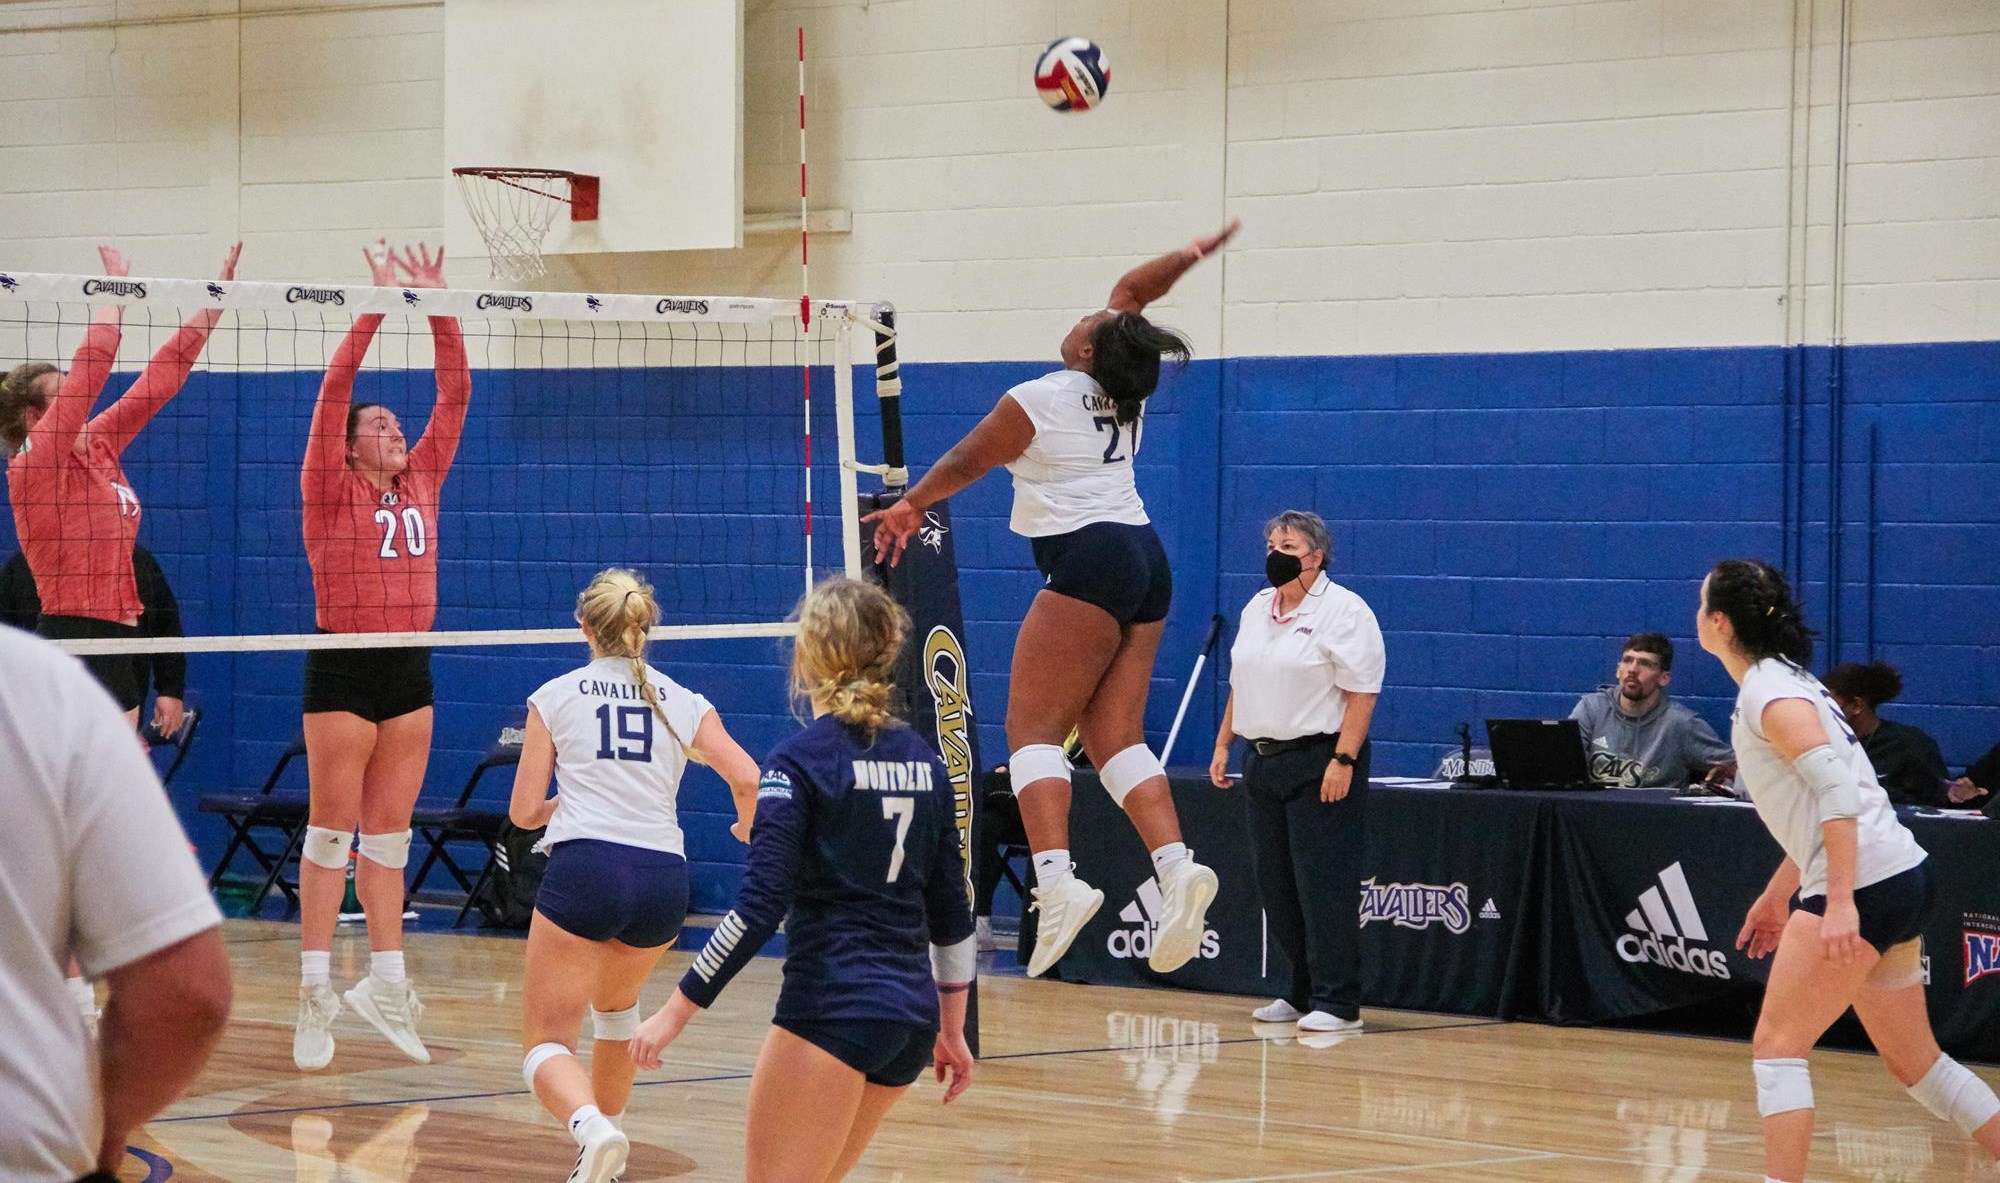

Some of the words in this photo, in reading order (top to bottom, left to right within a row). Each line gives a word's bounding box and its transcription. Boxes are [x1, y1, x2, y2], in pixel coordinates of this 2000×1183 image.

[83, 279, 147, 299] CAVALIERS
[286, 287, 345, 306] CAVALIERS
[476, 293, 533, 312] CAVALIERS
[656, 298, 708, 315] CAVALIERS
[374, 506, 427, 559] 20
[596, 703, 653, 763] 19
[852, 759, 934, 791] MONTREAT
[1589, 751, 1643, 789] CAVS
[881, 796, 915, 883] 7
[1359, 876, 1472, 935] AVALIERS
[1616, 931, 1731, 980] adidas
